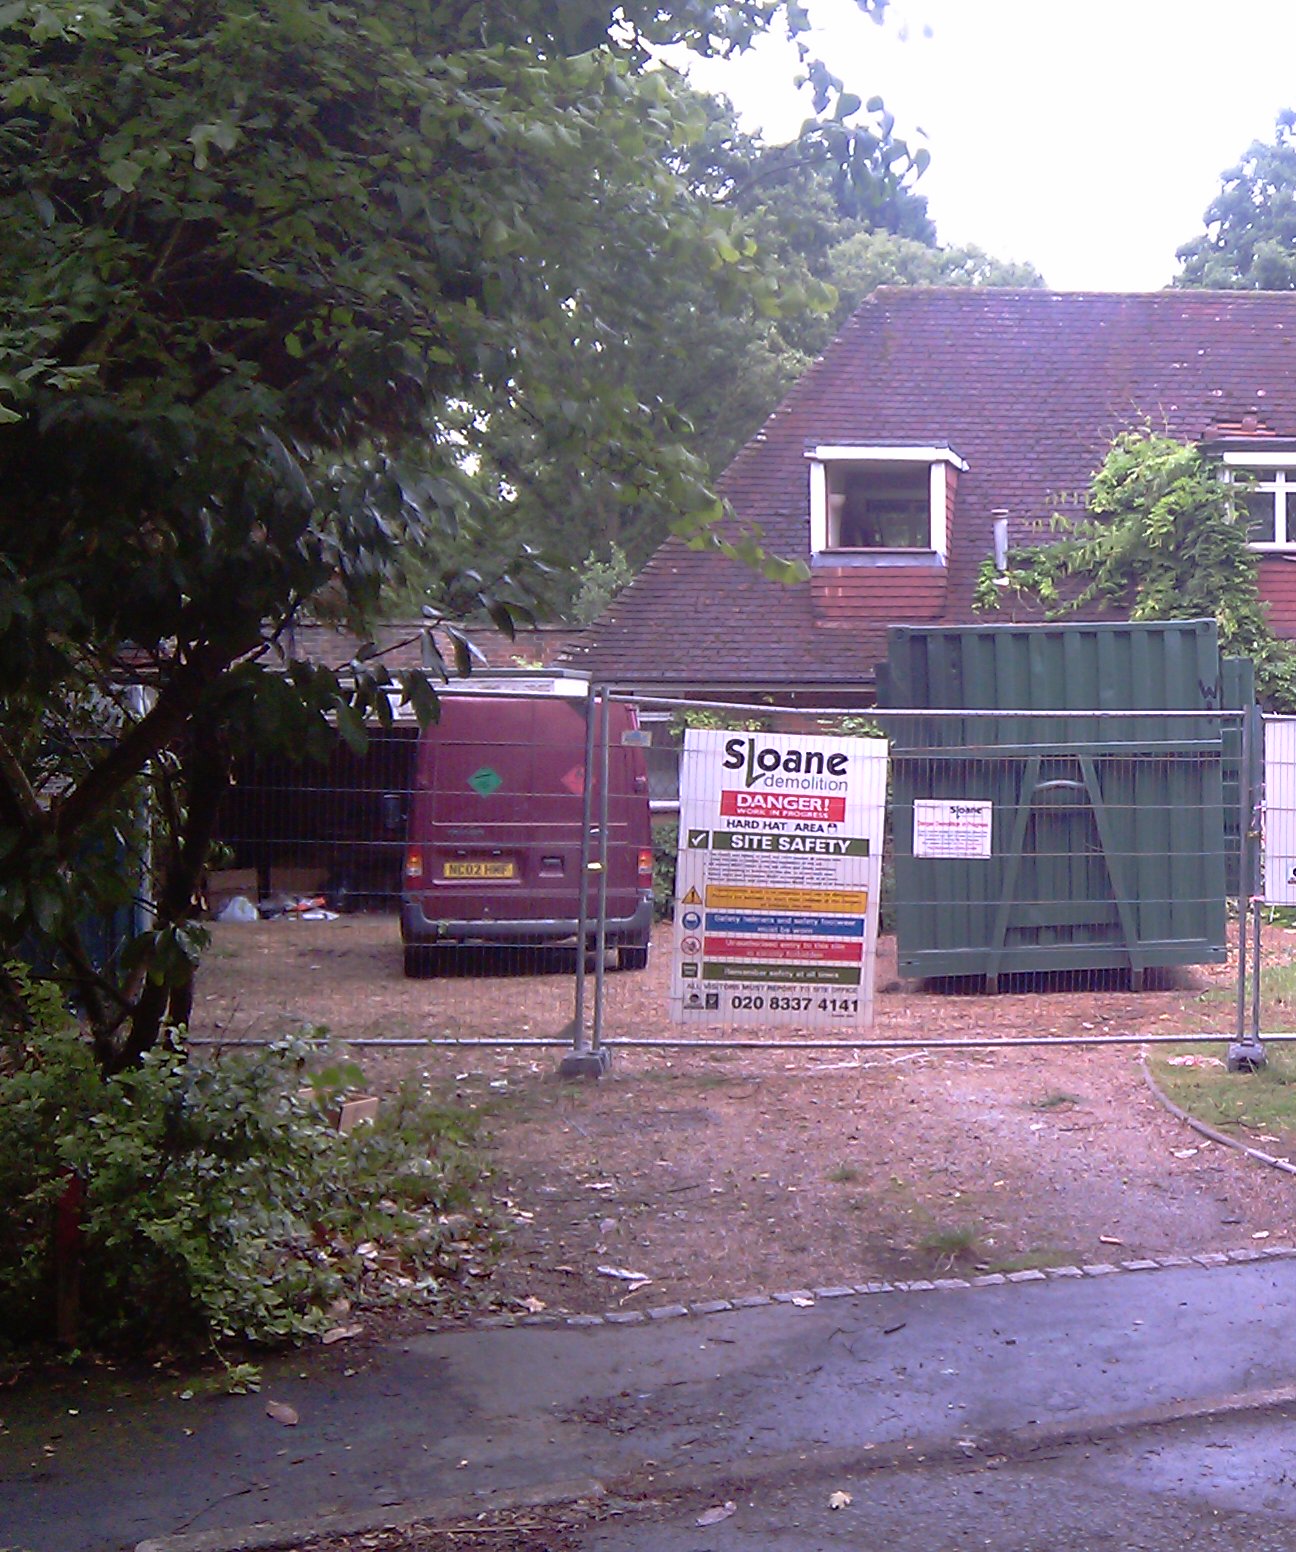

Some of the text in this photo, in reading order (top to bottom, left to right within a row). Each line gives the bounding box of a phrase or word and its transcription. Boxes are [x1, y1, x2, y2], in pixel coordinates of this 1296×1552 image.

[722, 738, 849, 788] Sloane
[764, 774, 848, 792] demolition
[736, 794, 830, 811] DANGER!
[782, 810, 829, 819] PROGRESS
[726, 819, 824, 833] HARD HAT AREA
[730, 834, 851, 854] SITE SAFETY
[731, 995, 858, 1013] 020 8337 4141
